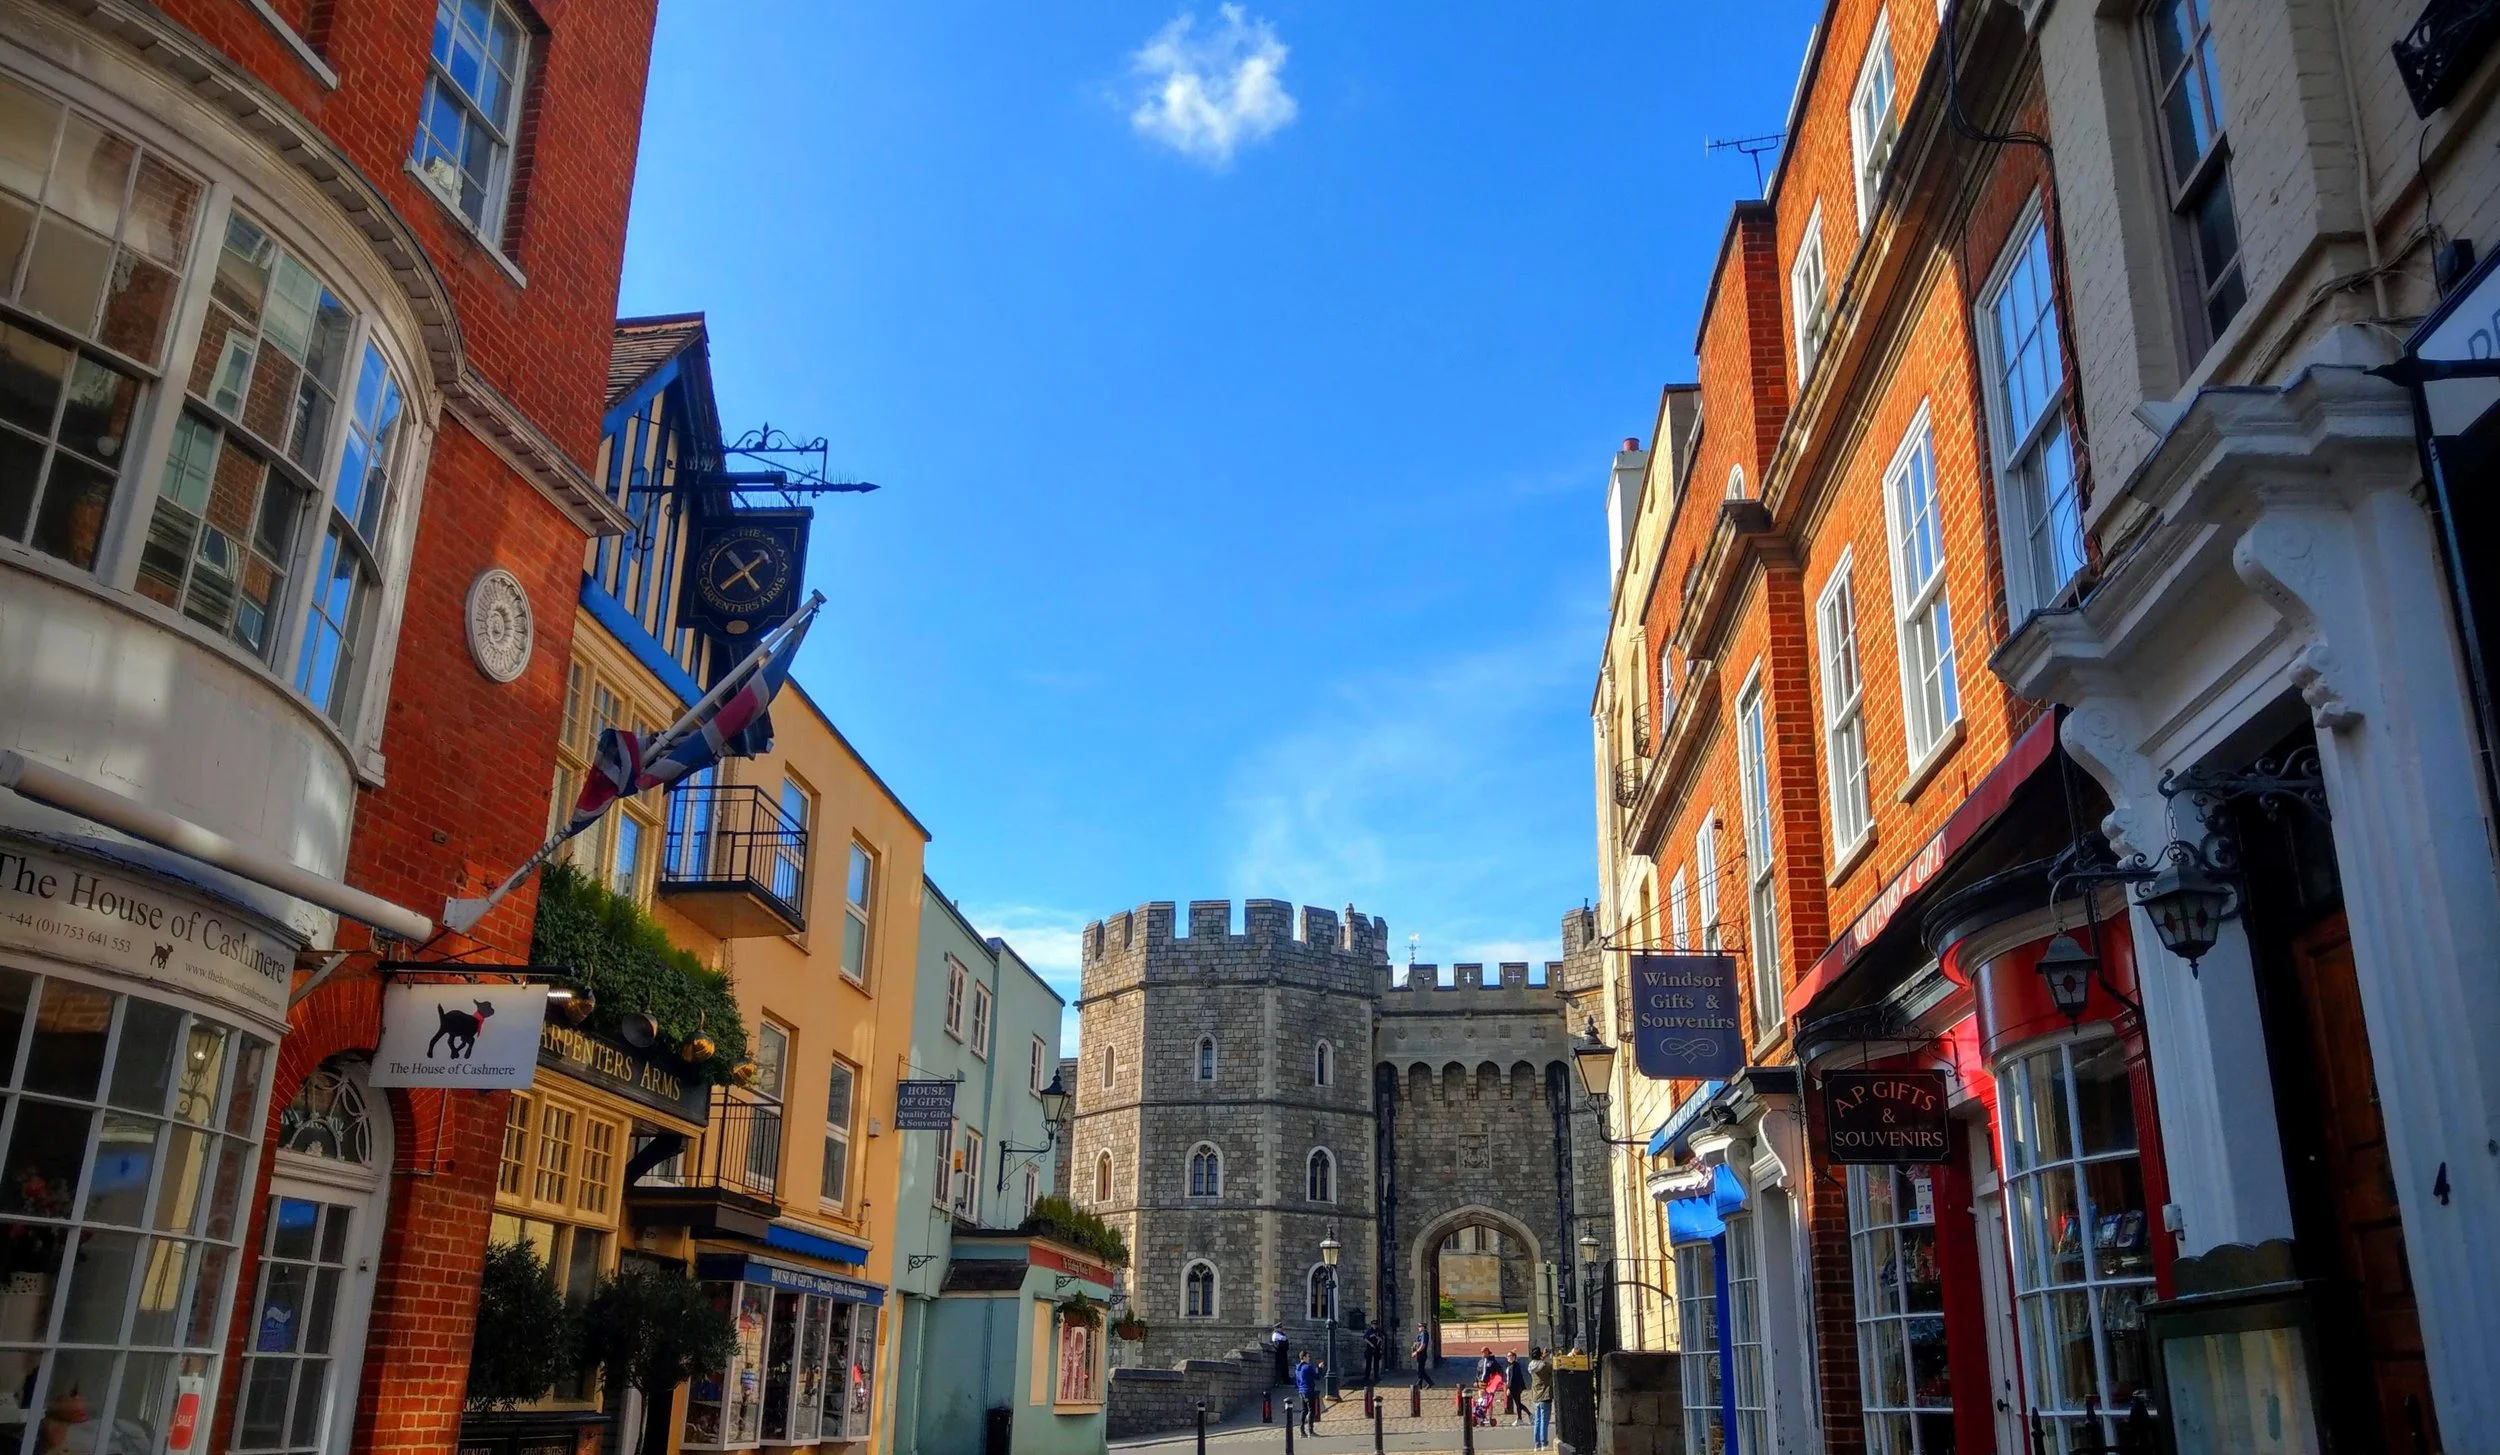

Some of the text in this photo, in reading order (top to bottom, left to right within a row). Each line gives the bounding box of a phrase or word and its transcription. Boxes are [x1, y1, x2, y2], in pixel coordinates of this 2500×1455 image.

[738, 528, 761, 538] THE
[700, 577, 786, 613] CARPENTERS ARMS
[1916, 827, 1947, 883] GIFTS
[0, 853, 286, 984] The House of Cashmere
[7, 912, 131, 953] +44 (0)1753 641 553
[1643, 972, 1724, 988] Windsor
[1651, 993, 1720, 1009] Gifts &
[1641, 1013, 1735, 1029] Souvenirs
[540, 1020, 681, 1101] ARPENTERS ARMS
[389, 1062, 515, 1076] The House of Cashmere
[908, 1086, 946, 1095] HOUSE
[1872, 1081, 1937, 1111] GIFTS
[900, 1097, 952, 1106] OF GIFTS
[897, 1111, 928, 1119] Quality
[907, 1119, 949, 1127] Souvenirs
[1882, 1107, 1896, 1124] &
[1834, 1131, 1944, 1148] SOUVENIRS
[772, 1268, 790, 1284] HOUSE
[798, 1274, 813, 1289] GIFTS
[817, 1278, 833, 1295] Quality
[176, 1415, 193, 1427] SALE
